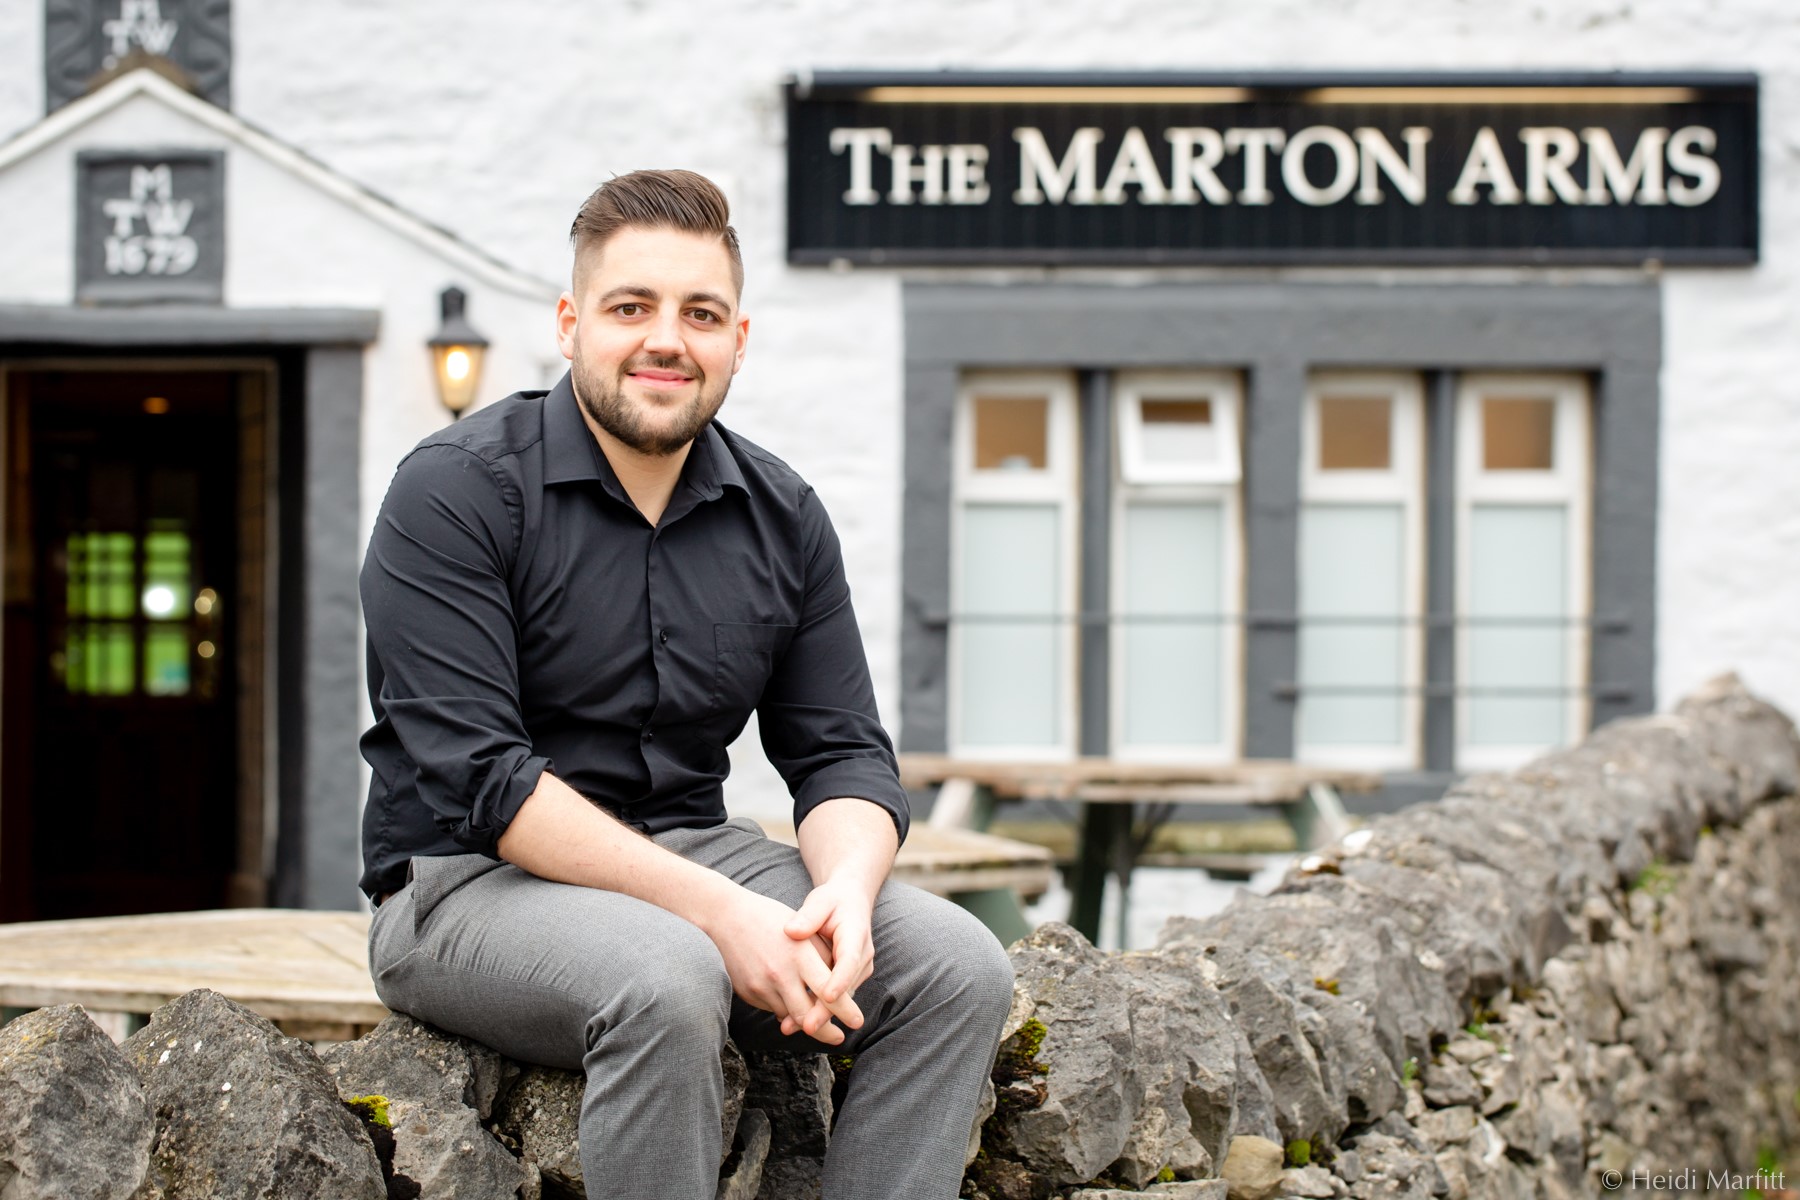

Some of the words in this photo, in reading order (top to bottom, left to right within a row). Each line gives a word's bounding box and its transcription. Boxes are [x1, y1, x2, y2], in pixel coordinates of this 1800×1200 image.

[130, 164, 172, 201] M
[1012, 125, 1432, 206] MARTON
[1448, 126, 1721, 206] ARMS
